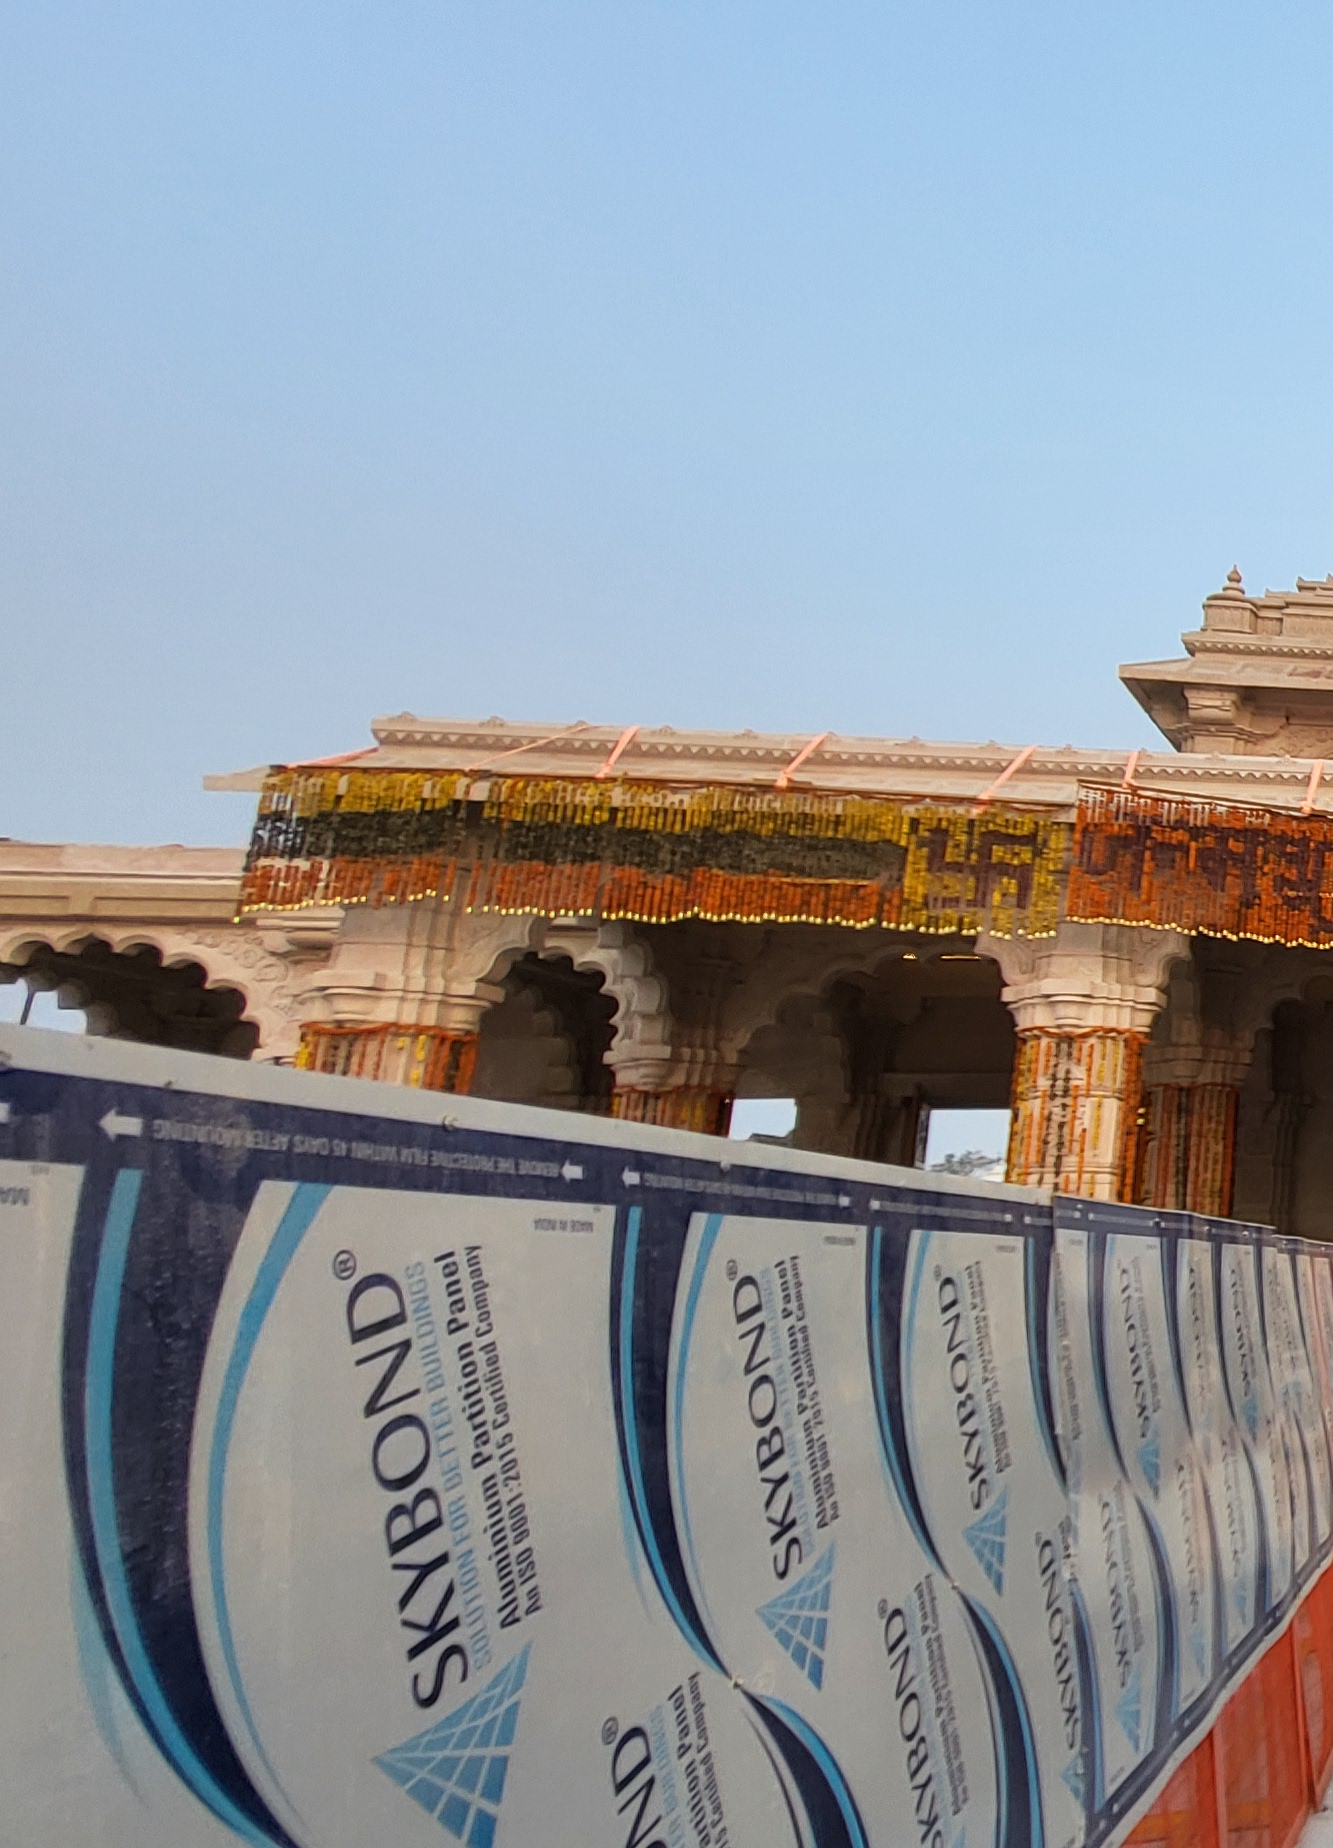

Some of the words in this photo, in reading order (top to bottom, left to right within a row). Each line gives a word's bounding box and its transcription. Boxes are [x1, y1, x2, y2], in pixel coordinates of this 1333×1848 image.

[405, 1261, 445, 1393] BUILDINGS
[434, 1251, 469, 1335] Panel
[464, 1246, 495, 1338] Company
[774, 1260, 793, 1319] Panel
[457, 1341, 494, 1469] Partition
[479, 1341, 510, 1430] Certified
[787, 1324, 809, 1416] Partition
[803, 1419, 829, 1530] Aluminium
[447, 1494, 472, 1547] FOR
[481, 1473, 521, 1629] Aluminium
[456, 1547, 492, 1672] SOLUTION
[516, 1547, 536, 1588] ISO
[525, 1585, 543, 1616] An
[667, 1685, 692, 1761] Panel
